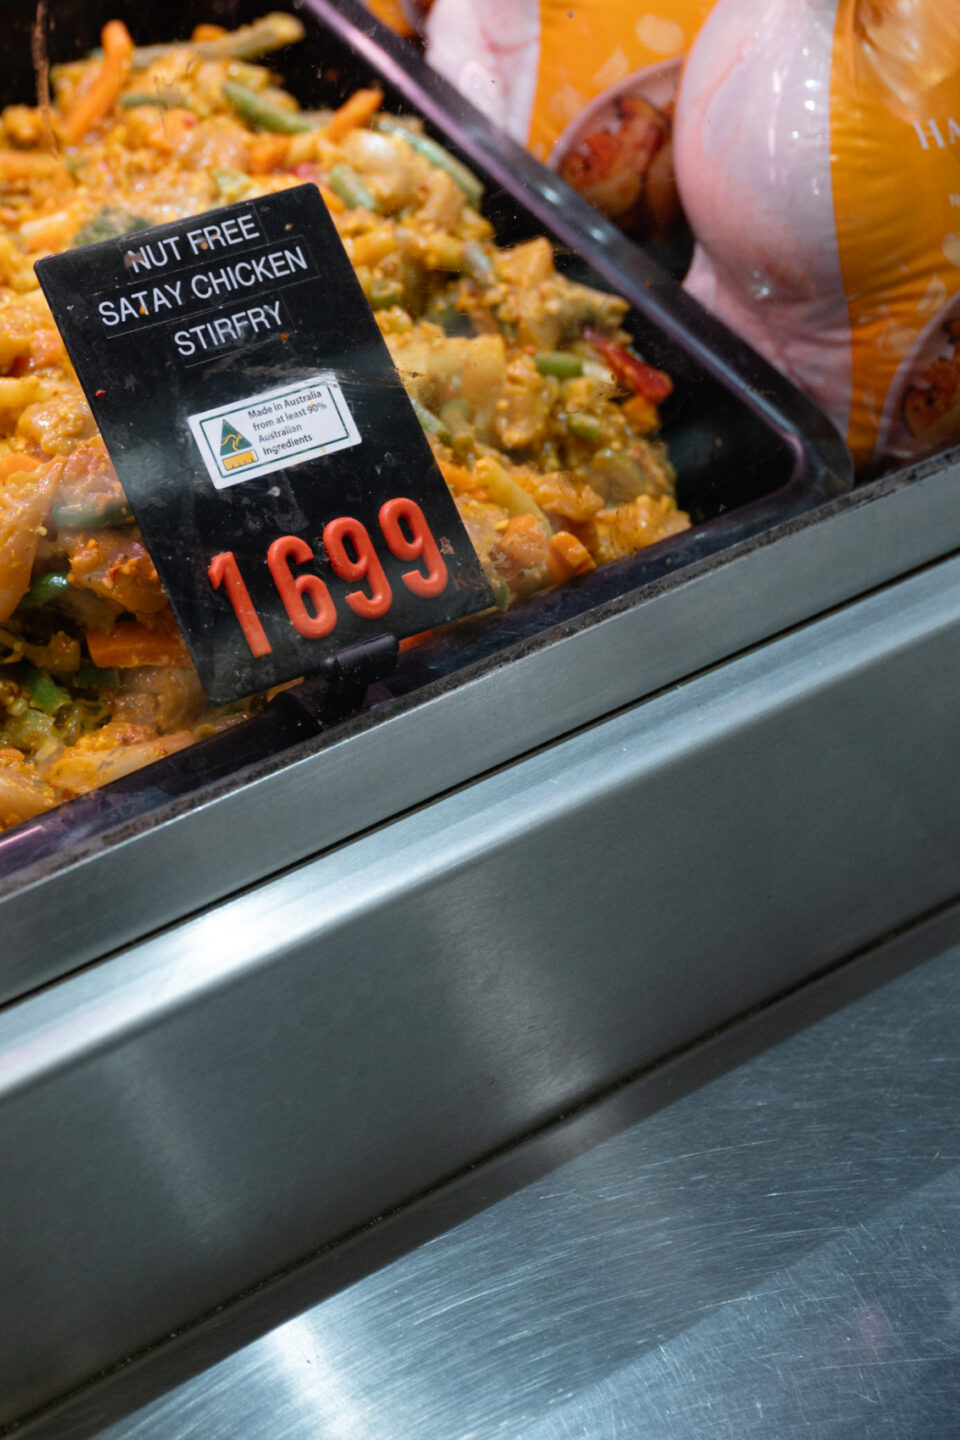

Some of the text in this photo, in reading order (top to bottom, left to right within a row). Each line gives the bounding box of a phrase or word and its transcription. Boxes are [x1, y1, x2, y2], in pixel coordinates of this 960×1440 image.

[127, 214, 260, 273] NUT FREE
[98, 246, 308, 326] SATAY CHICKEN
[174, 300, 282, 356] STIRFRY
[247, 391, 322, 420] Made in Australia
[252, 402, 328, 432] from at least 90%
[258, 424, 303, 443] Australian
[262, 434, 313, 456] Ingredients
[208, 497, 448, 658] 1699
